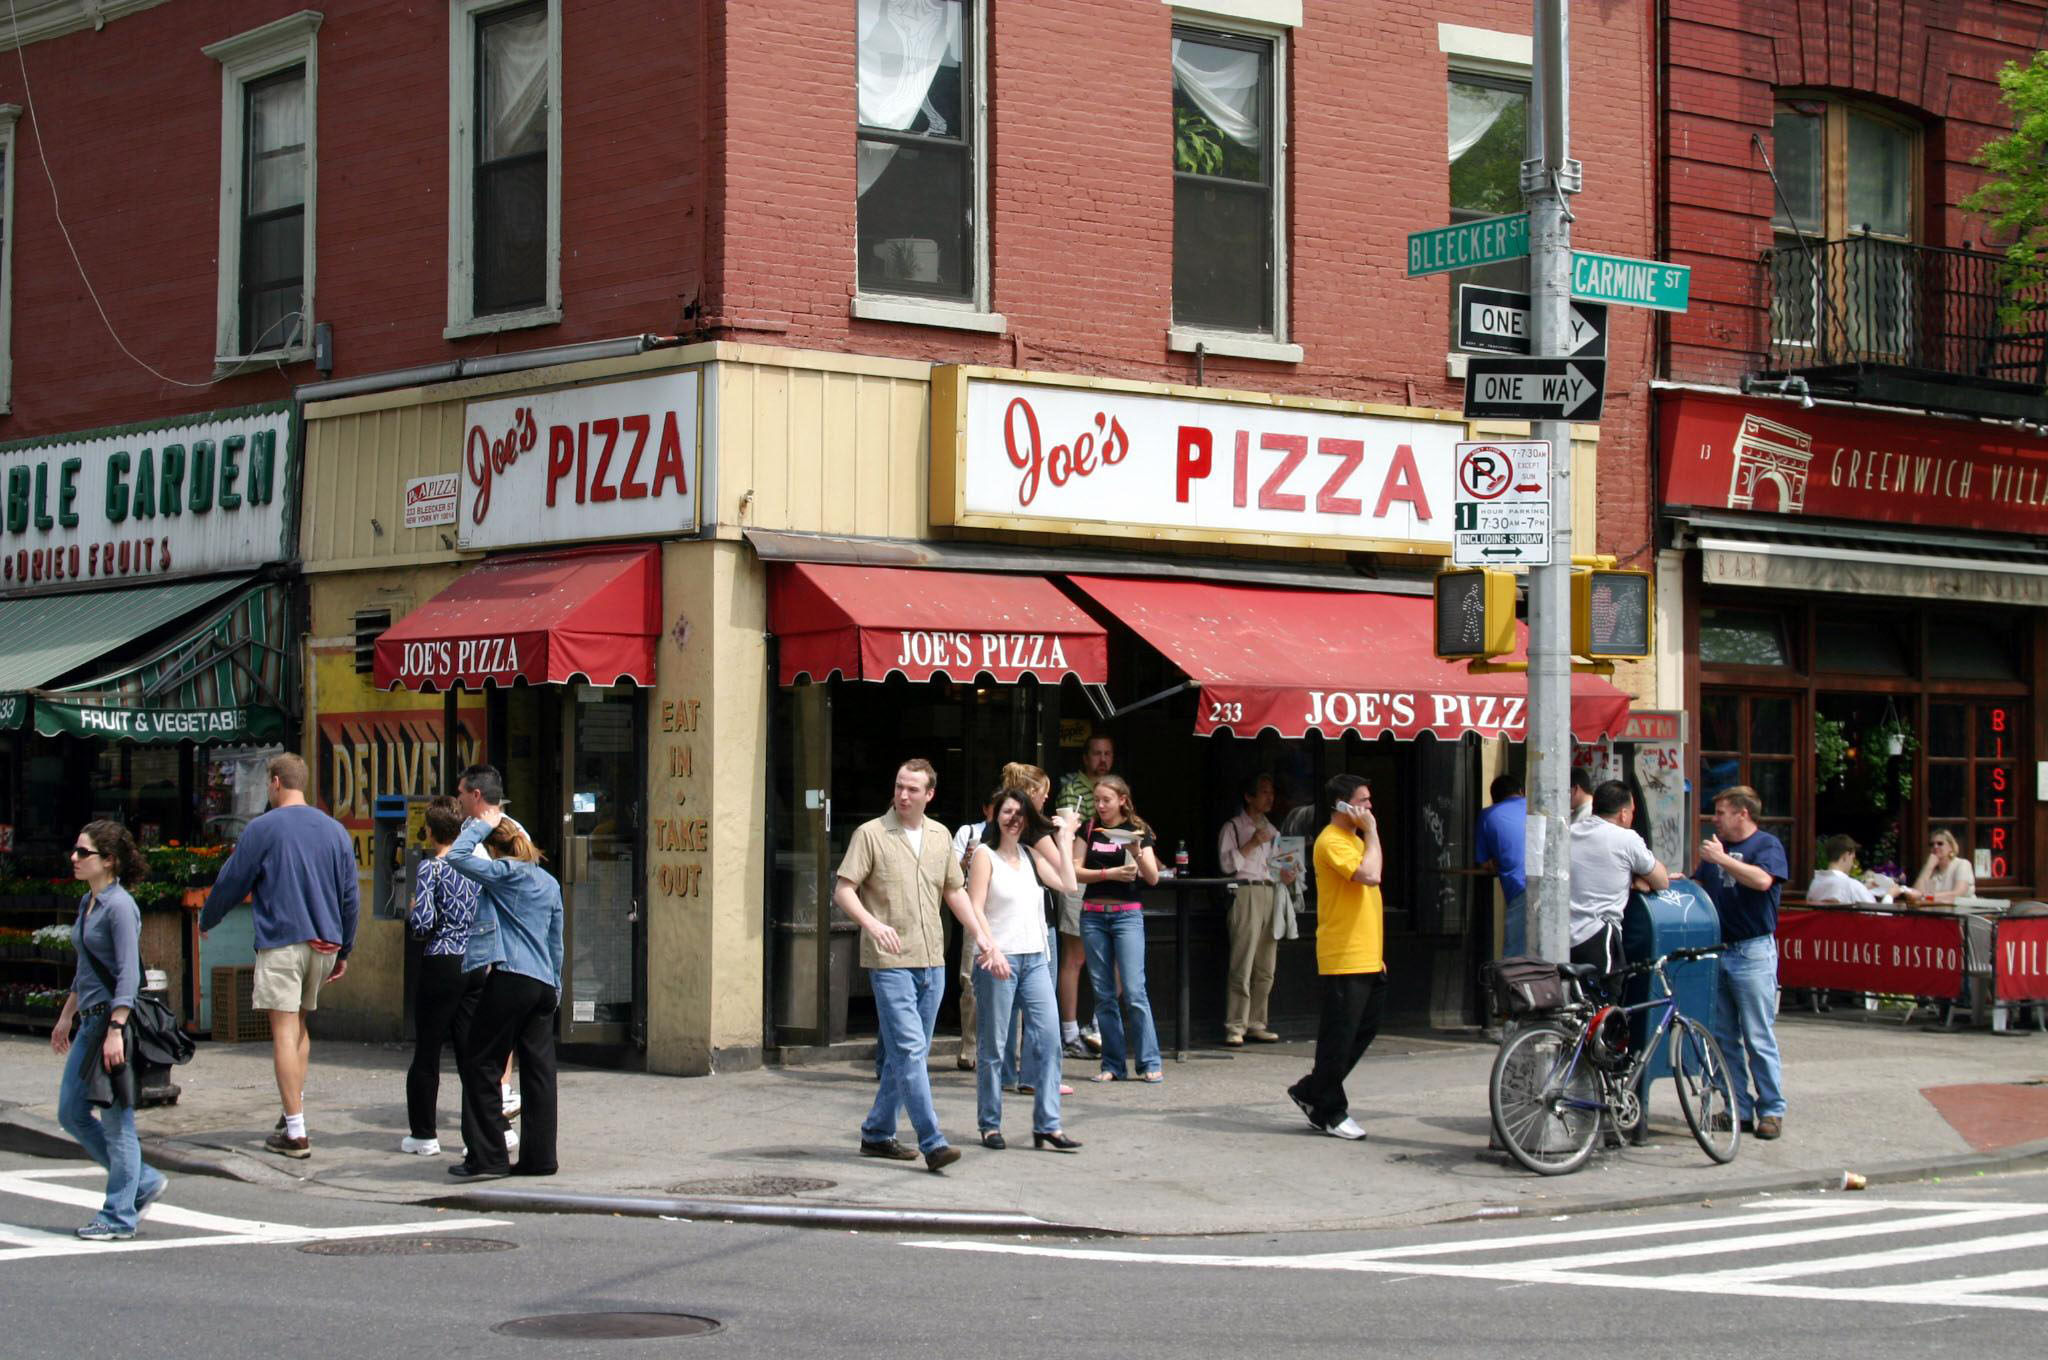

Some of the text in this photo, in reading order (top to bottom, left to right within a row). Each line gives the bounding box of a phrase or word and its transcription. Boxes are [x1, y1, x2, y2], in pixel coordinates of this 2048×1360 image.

[1411, 217, 1527, 271] BLEECKER ST
[1575, 257, 1683, 302] CARMINE ST
[1482, 308, 1522, 335] ONE
[1485, 377, 1584, 402] ONE WAY
[467, 407, 688, 525] Joe's PIZZA
[1004, 396, 1433, 520] Joe's PIZZA
[1700, 444, 1711, 460] 13
[0, 428, 276, 533] BLE GARDEN
[428, 479, 457, 497] PIZZA
[1831, 448, 1974, 499] GREENWICH
[1462, 505, 1469, 529] 1
[1461, 534, 1543, 544] INCLUDING SUNDAY
[89, 536, 171, 577] FRUITS
[1719, 554, 1757, 579] BAR
[400, 637, 519, 676] JOE'S PIZZA
[898, 631, 1068, 668] JOE'S PIZZA
[80, 709, 131, 732] FRUIT
[135, 713, 149, 732] &
[661, 699, 700, 732] EAT
[1209, 691, 1527, 729] 233 JOE'S PIZZ
[1625, 719, 1672, 737] ATM
[669, 746, 692, 777] IN
[1992, 708, 2006, 879] BISTRO
[655, 819, 708, 852] TAKE
[659, 863, 702, 898] OUT
[1814, 939, 1881, 965] VILLAGE
[1893, 945, 1956, 971] BISTRO
[2006, 940, 2048, 976] VIL
